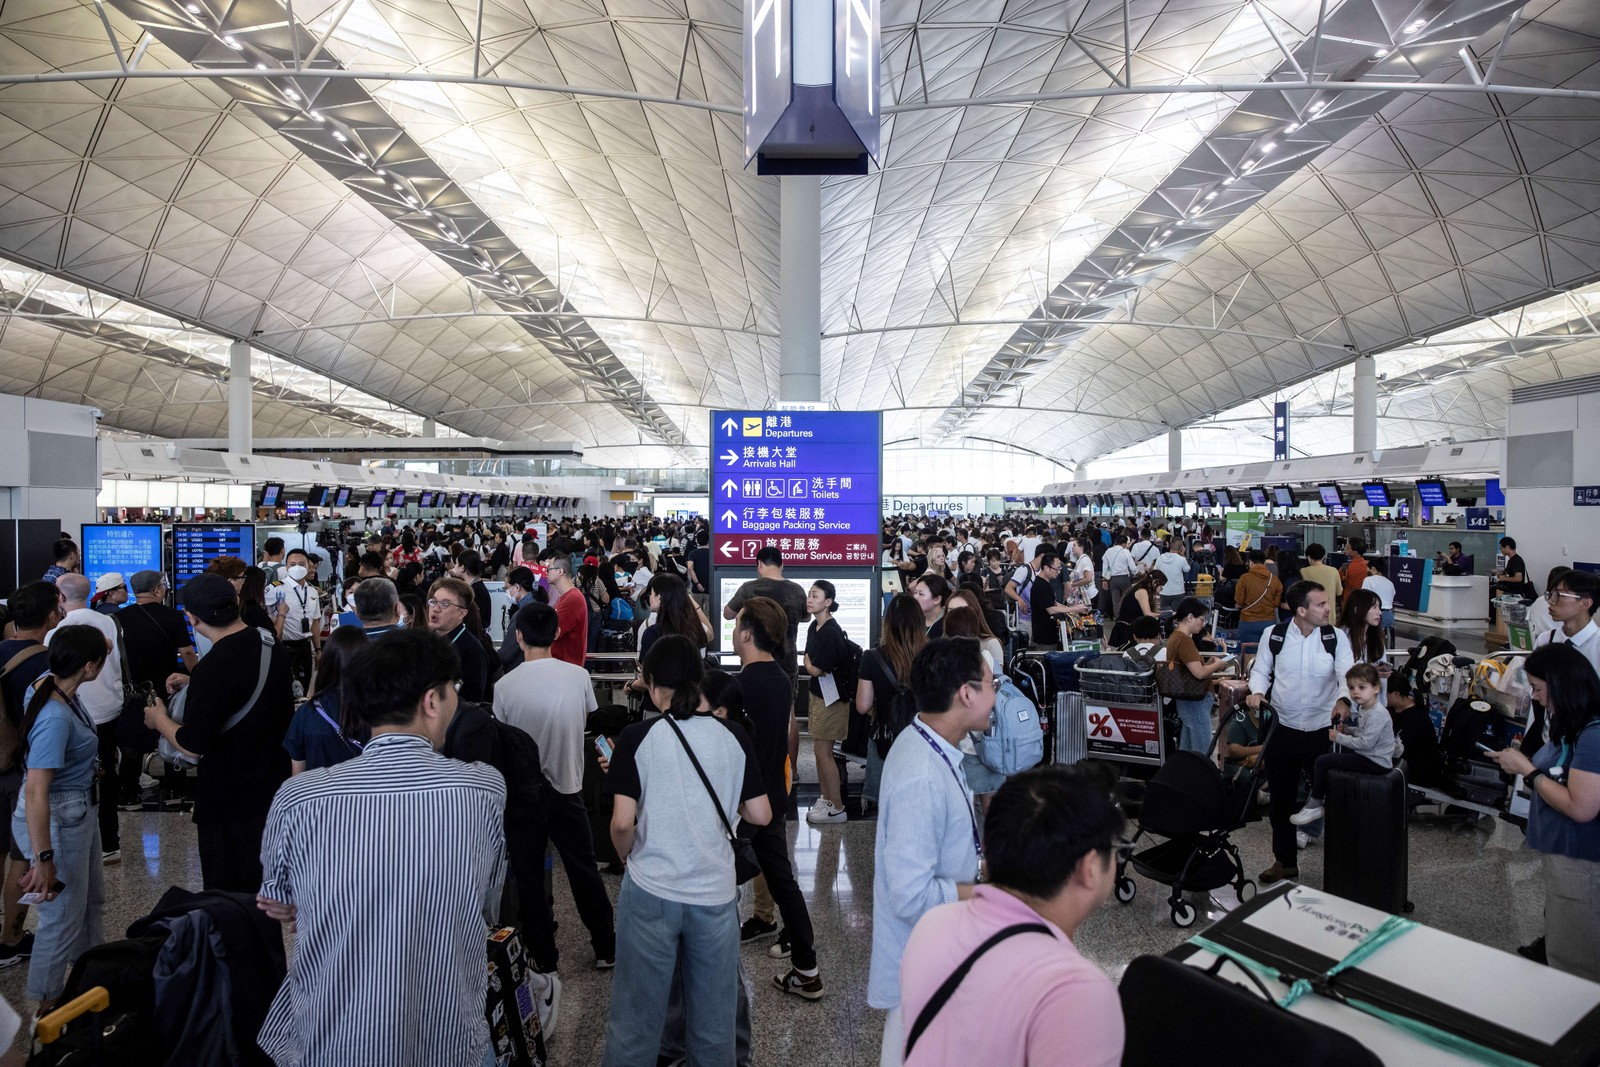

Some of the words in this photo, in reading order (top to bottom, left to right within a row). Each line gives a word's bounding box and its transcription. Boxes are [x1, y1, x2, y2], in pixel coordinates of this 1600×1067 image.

[766, 416, 792, 428] 離港
[766, 430, 813, 438] Departures
[743, 446, 797, 458] 接機大堂
[812, 478, 852, 489] 洗手間
[812, 491, 839, 499] Toilets
[894, 500, 963, 513] Departures
[743, 507, 825, 520] 行李包裝服務
[742, 521, 780, 530] Baggage
[783, 521, 816, 530] Packing
[818, 521, 850, 529] Service
[1258, 514, 1264, 527] 2
[1469, 518, 1488, 526] SAS
[766, 538, 820, 550] 旅客服務
[781, 552, 807, 560] tomer
[810, 552, 842, 560] Service
[1088, 713, 1112, 737] %
[1324, 924, 1361, 940] 香港郵
[1350, 923, 1370, 933] Po
